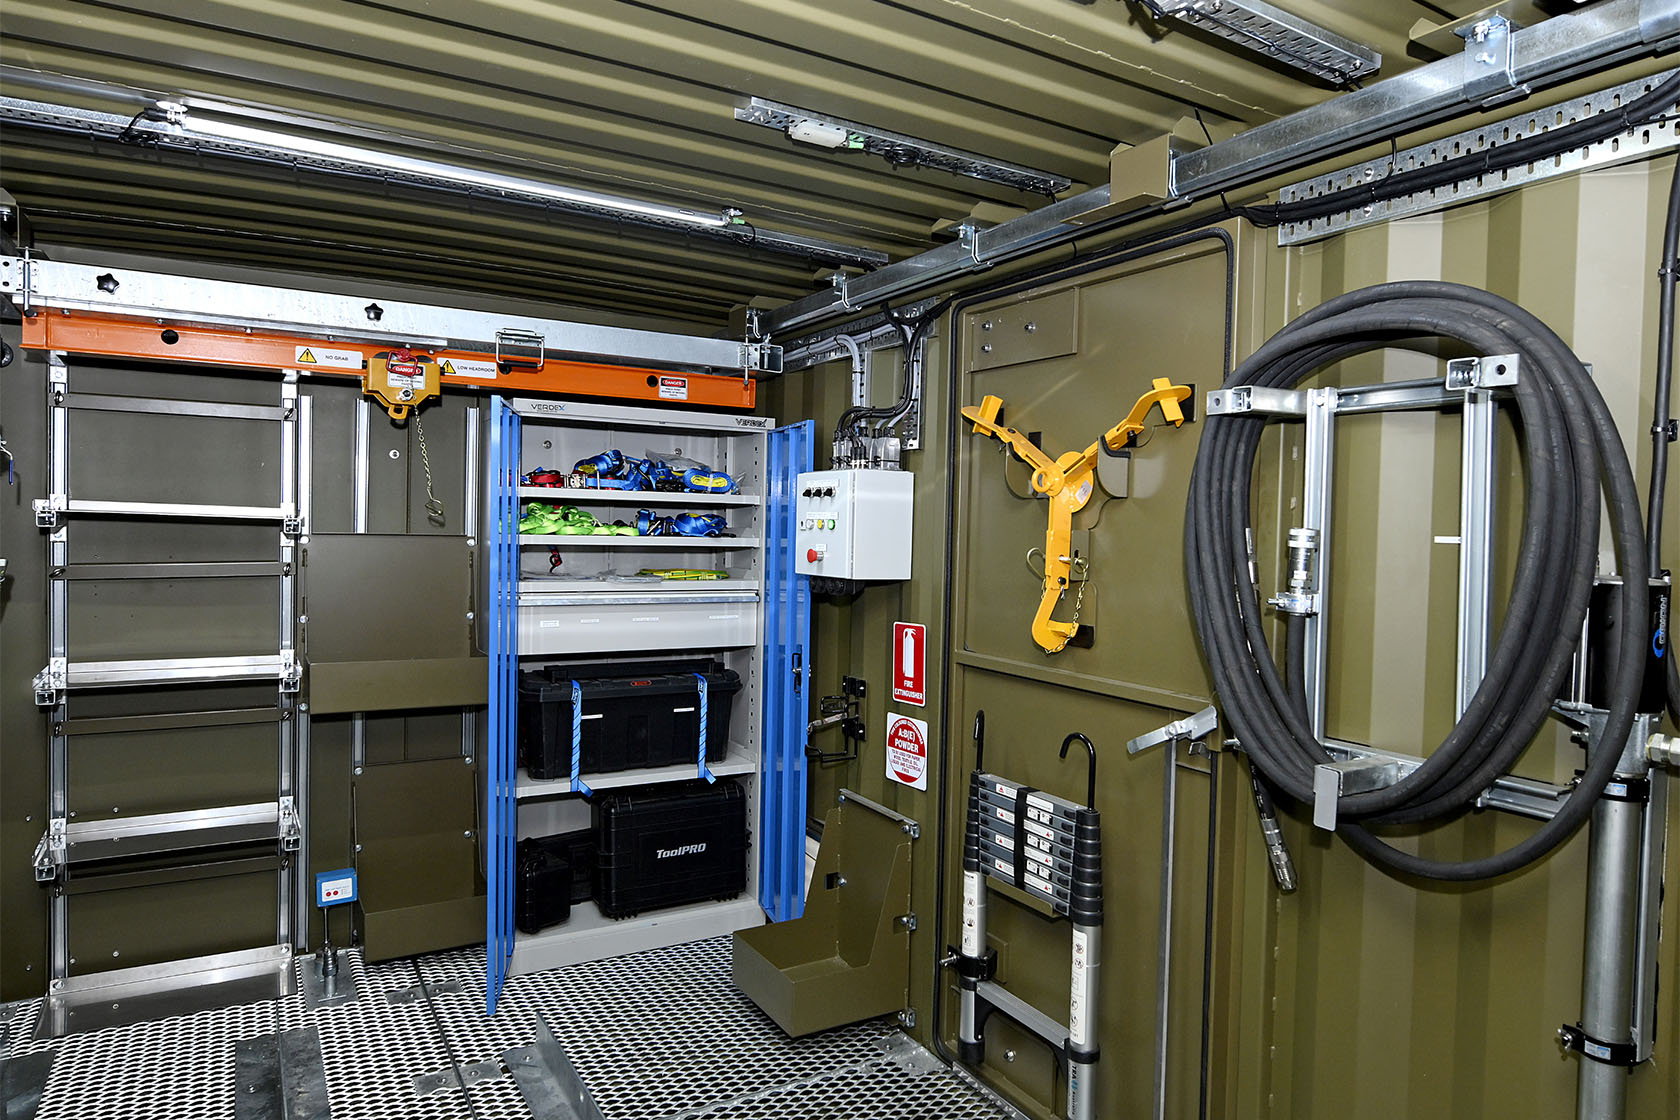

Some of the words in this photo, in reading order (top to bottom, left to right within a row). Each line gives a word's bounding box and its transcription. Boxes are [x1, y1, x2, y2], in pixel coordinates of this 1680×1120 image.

[530, 403, 567, 411] VERDEX
[904, 680, 914, 688] FIRE
[894, 737, 919, 753] POWDER
[656, 843, 707, 859] ToolPRO
